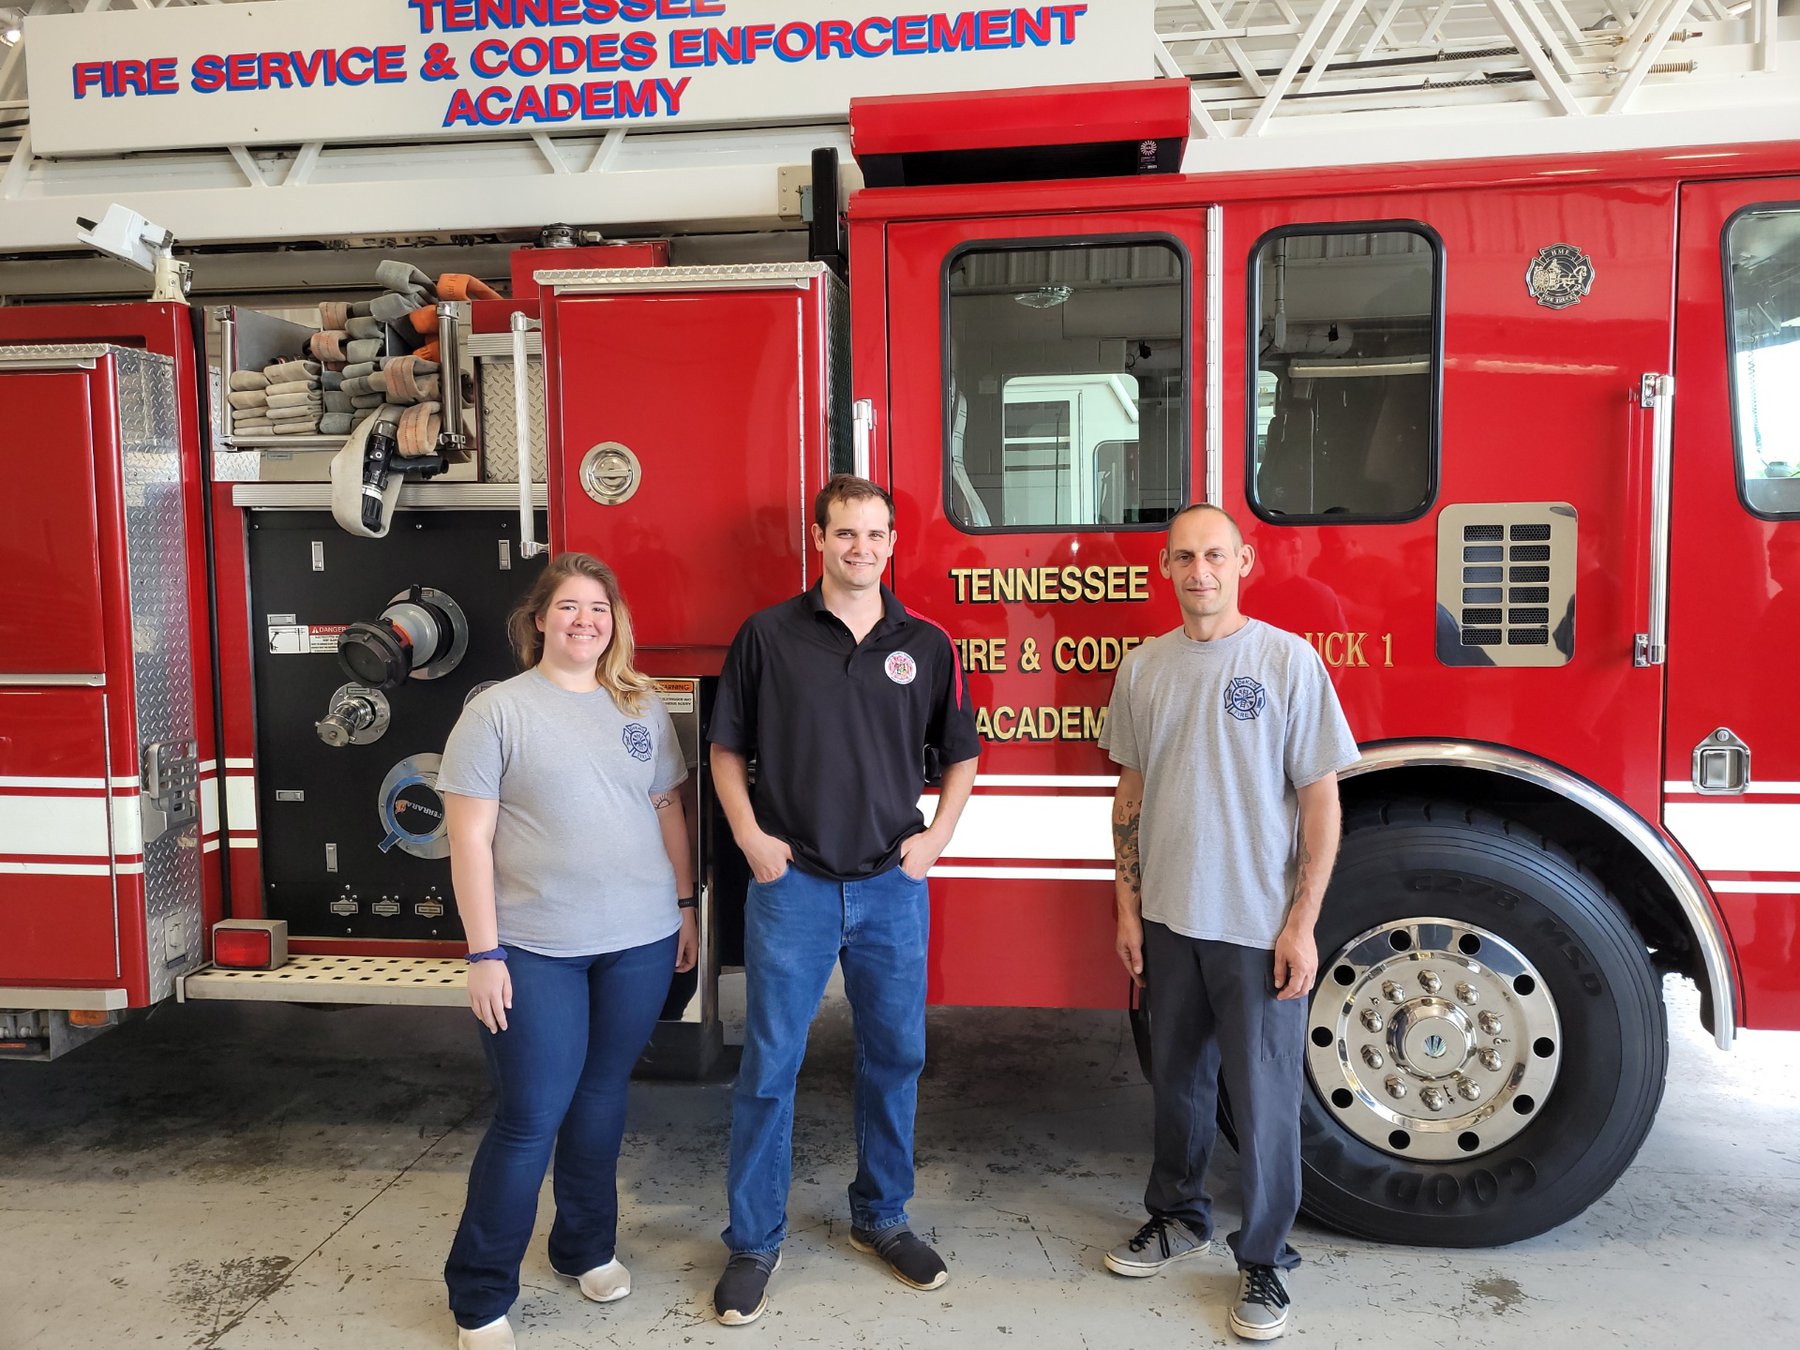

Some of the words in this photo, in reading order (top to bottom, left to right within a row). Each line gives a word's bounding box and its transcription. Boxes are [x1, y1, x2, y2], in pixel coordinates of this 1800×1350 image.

[73, 58, 180, 99] FIRE
[190, 45, 407, 93] SERVICE
[420, 42, 460, 81] &
[470, 30, 658, 79] CODES
[668, 4, 1087, 69] ENFORCEMENT
[442, 76, 692, 127] ACADEMY
[951, 565, 1149, 602] TENNESSEE
[1019, 636, 1042, 672] &
[1304, 631, 1370, 668] UCK
[1381, 632, 1394, 668] 1
[975, 706, 1108, 741] ACADEM
[1234, 710, 1249, 718] FIRE
